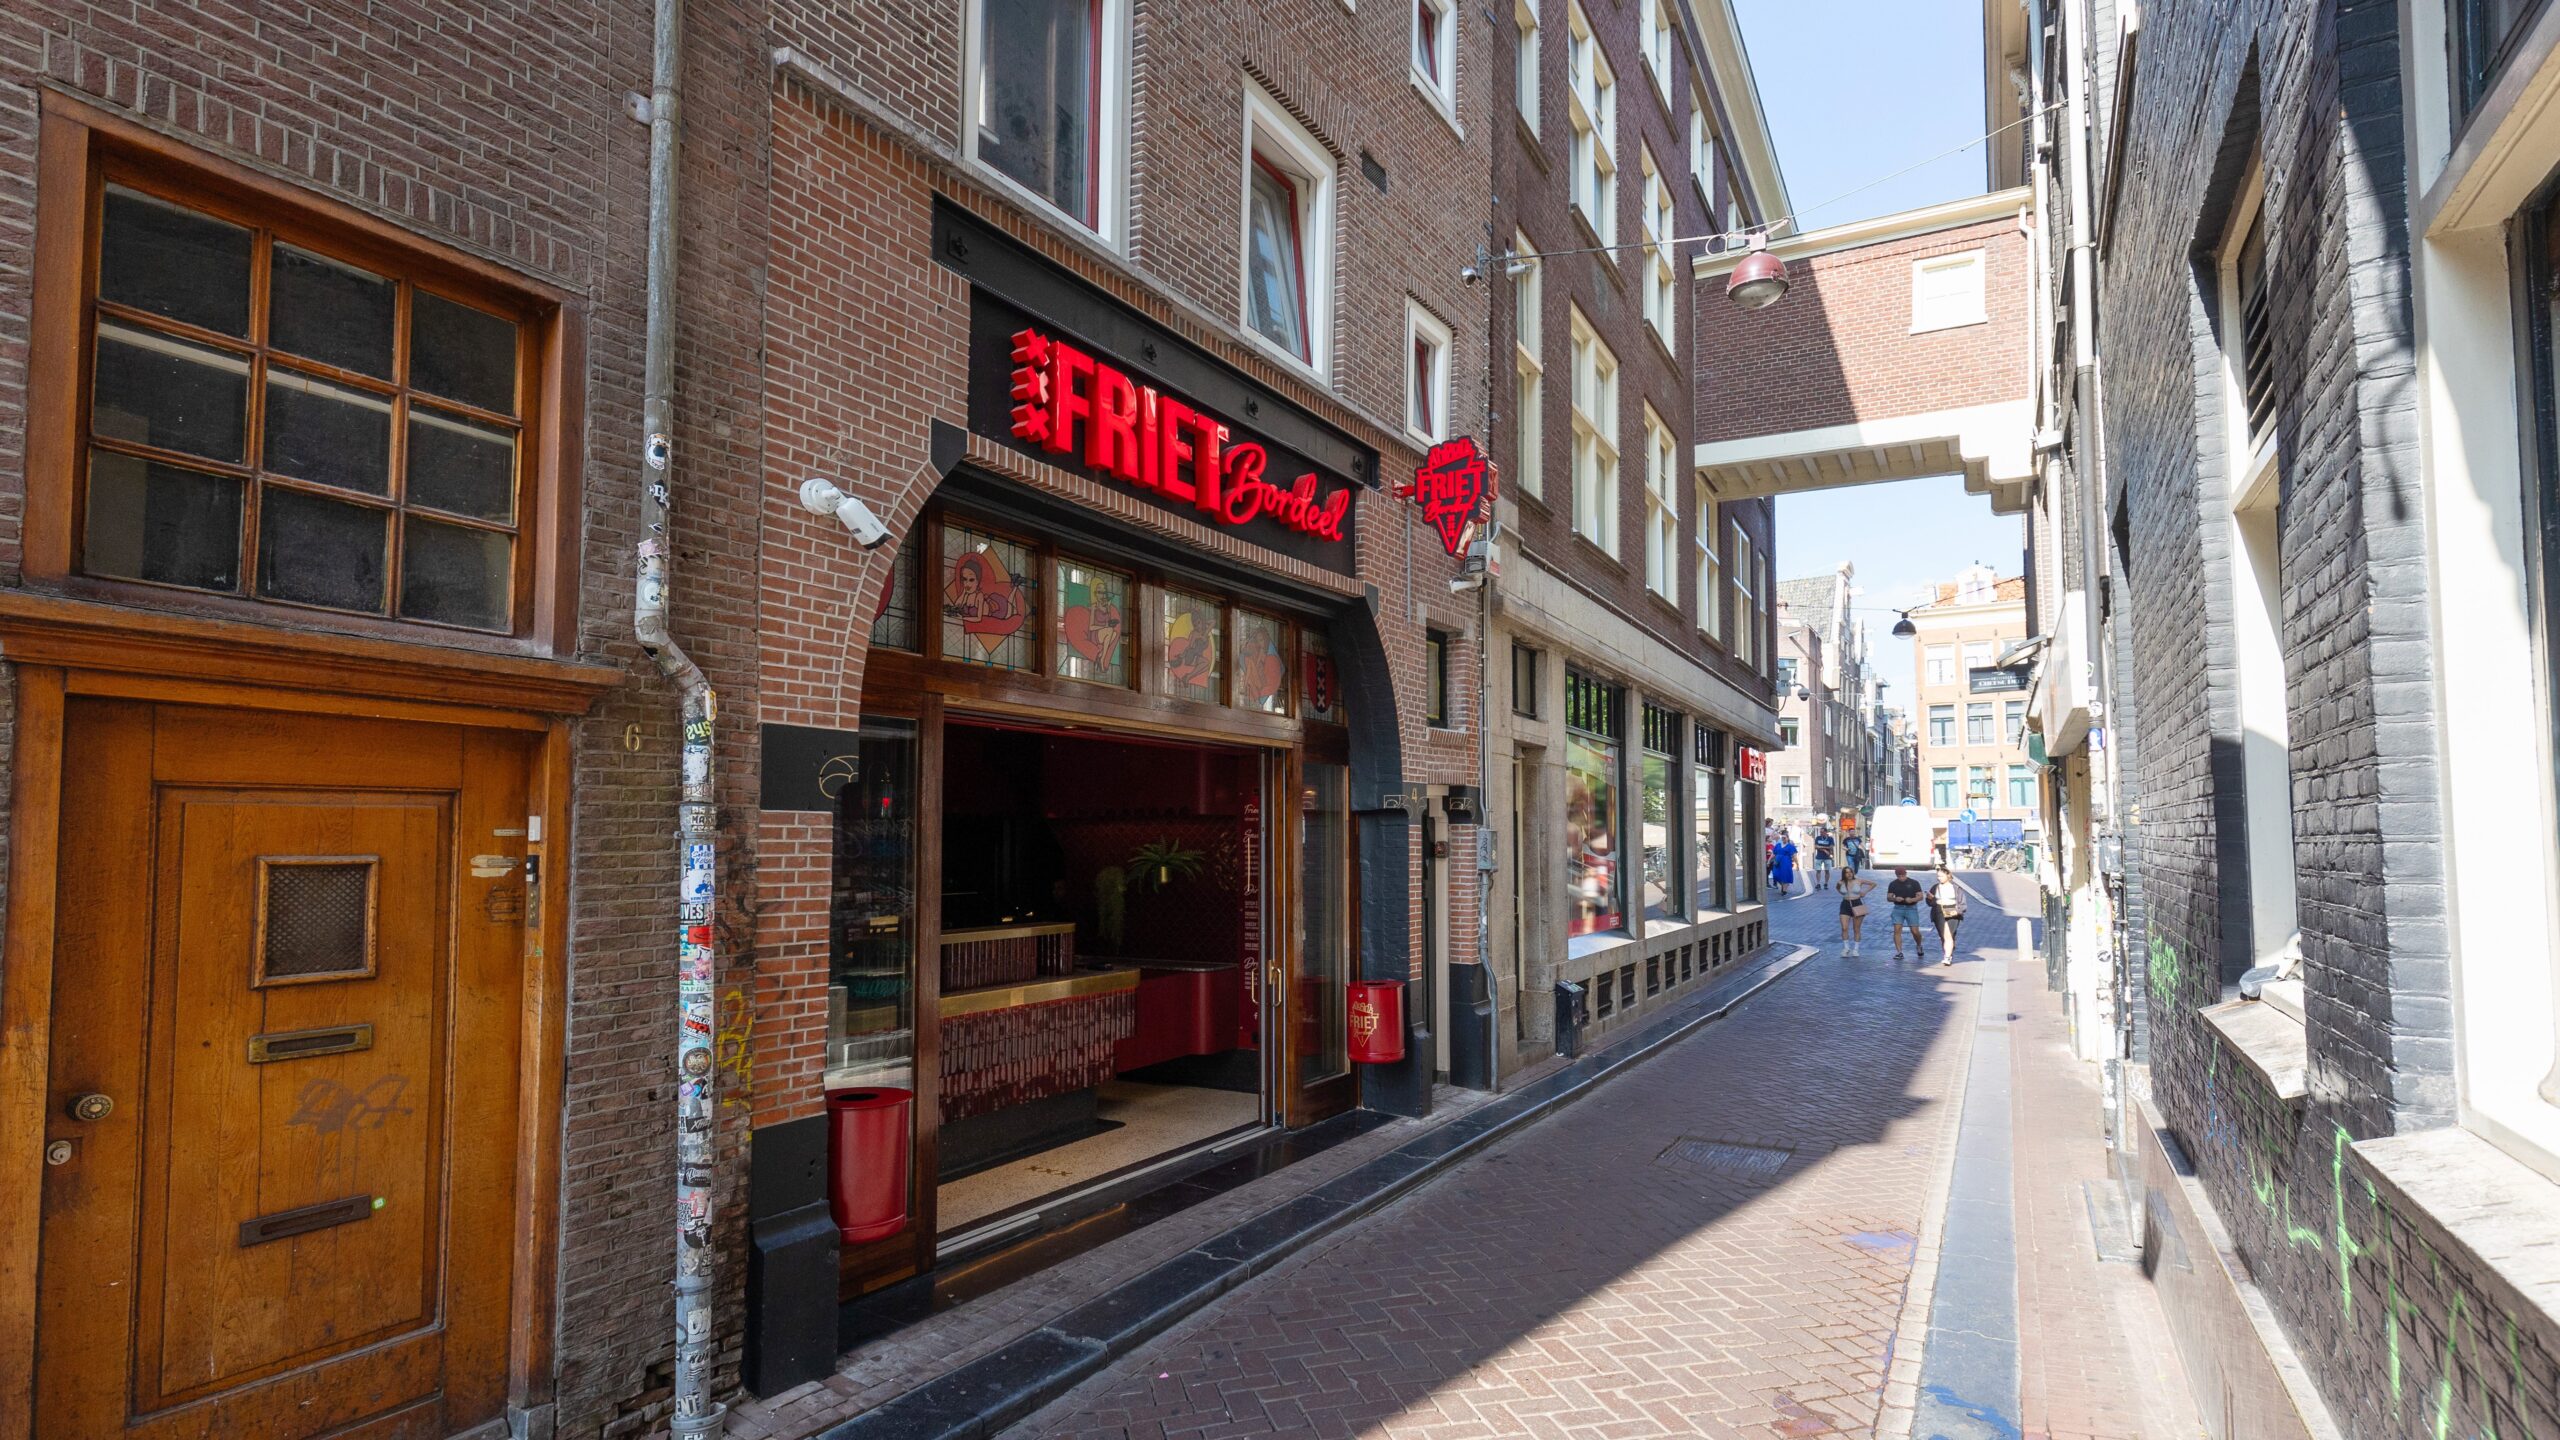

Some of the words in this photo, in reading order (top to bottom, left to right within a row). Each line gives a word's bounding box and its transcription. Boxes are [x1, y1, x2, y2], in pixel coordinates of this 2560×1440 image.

[1042, 340, 1230, 513] FRIET
[1217, 441, 1350, 542] Bordeel
[1416, 461, 1486, 503] FRIET
[626, 724, 640, 751] 6
[1411, 787, 1418, 803] 4
[1349, 1013, 1379, 1030] FRIET
